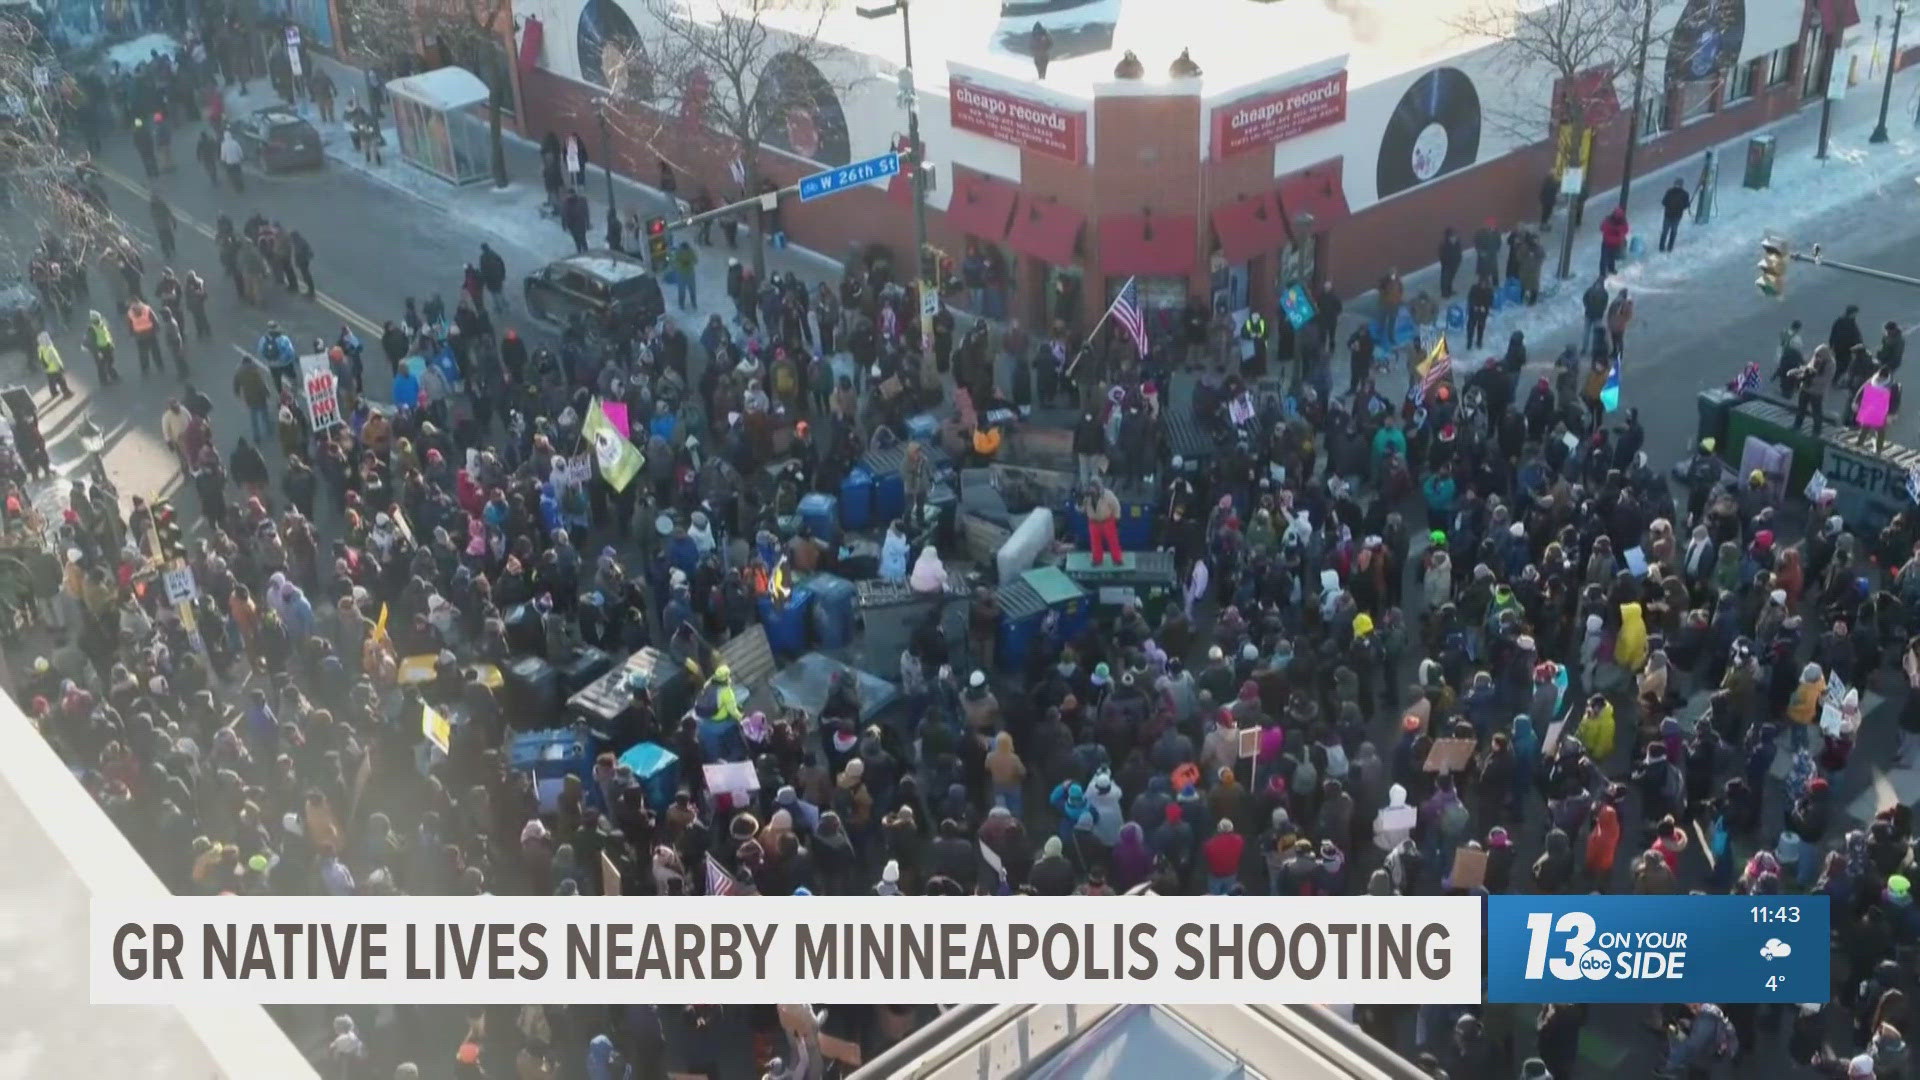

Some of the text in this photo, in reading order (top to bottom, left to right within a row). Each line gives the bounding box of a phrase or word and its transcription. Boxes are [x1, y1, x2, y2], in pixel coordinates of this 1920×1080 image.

[956, 88, 1007, 116] cheapo
[1008, 103, 1066, 133] records
[1231, 99, 1284, 129] cheapo
[1286, 81, 1340, 111] records
[820, 176, 832, 190] W
[839, 164, 873, 186] 26th
[879, 157, 896, 174] St
[308, 375, 332, 395] NO
[312, 397, 336, 417] NO
[170, 580, 189, 591] WAY
